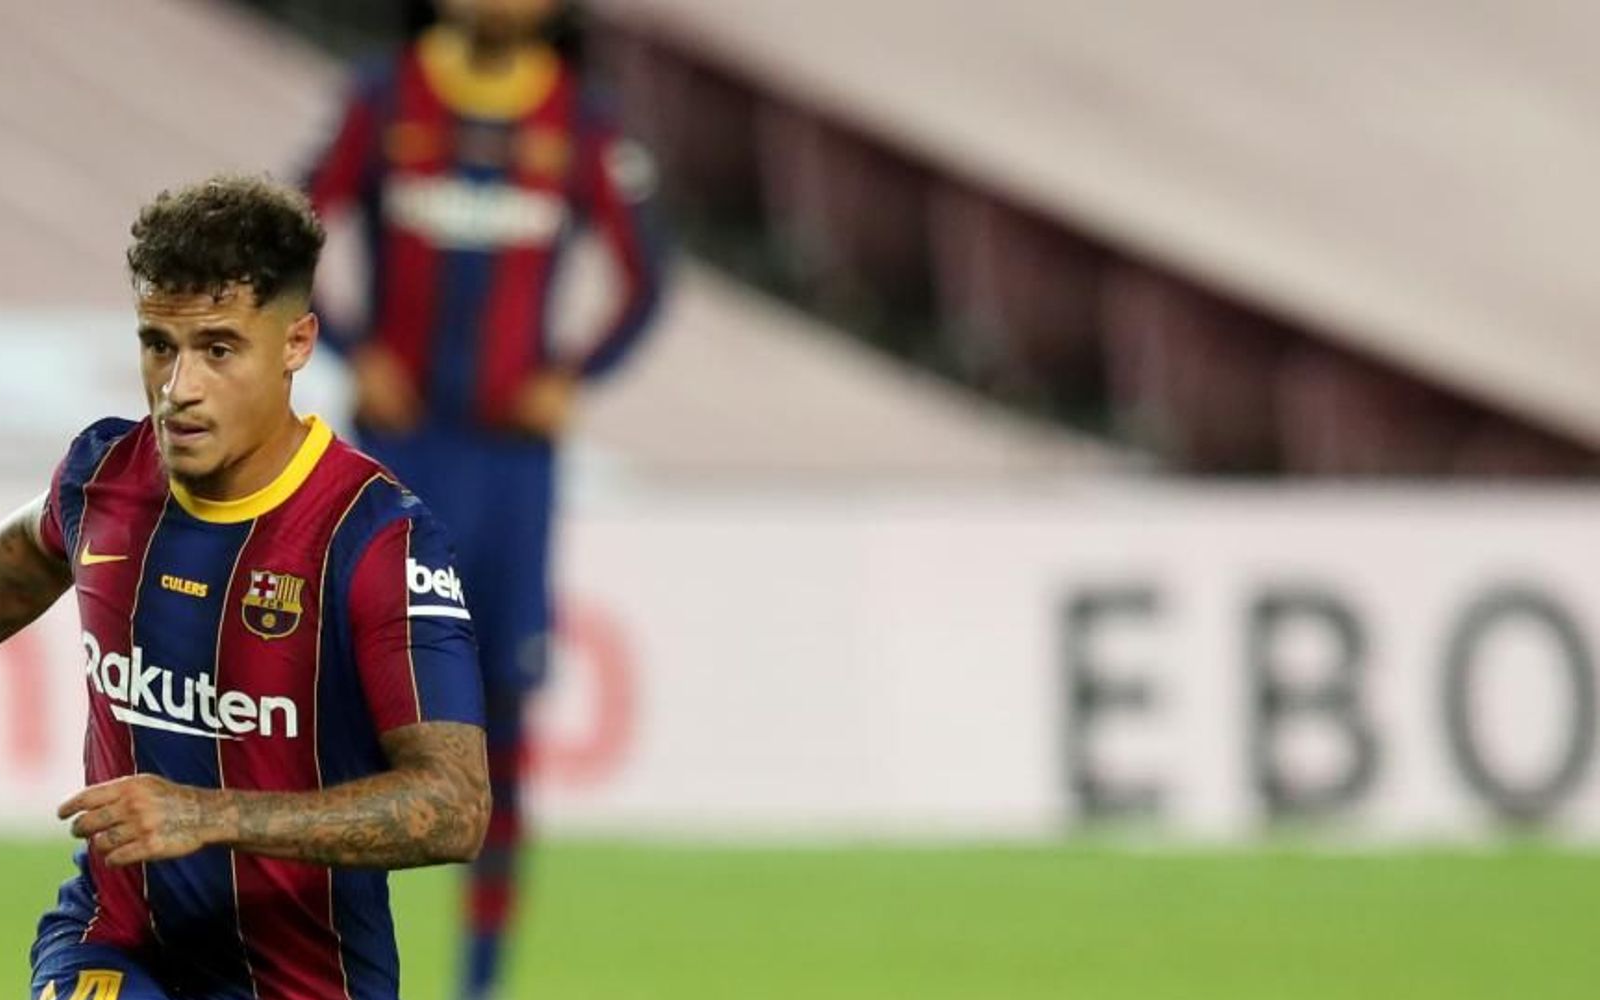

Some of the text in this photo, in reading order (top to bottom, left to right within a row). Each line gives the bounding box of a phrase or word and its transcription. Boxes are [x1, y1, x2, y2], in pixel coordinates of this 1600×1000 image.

[161, 574, 208, 598] CULERS
[82, 630, 298, 738] Rakuten
[1056, 580, 1599, 824] EBO
